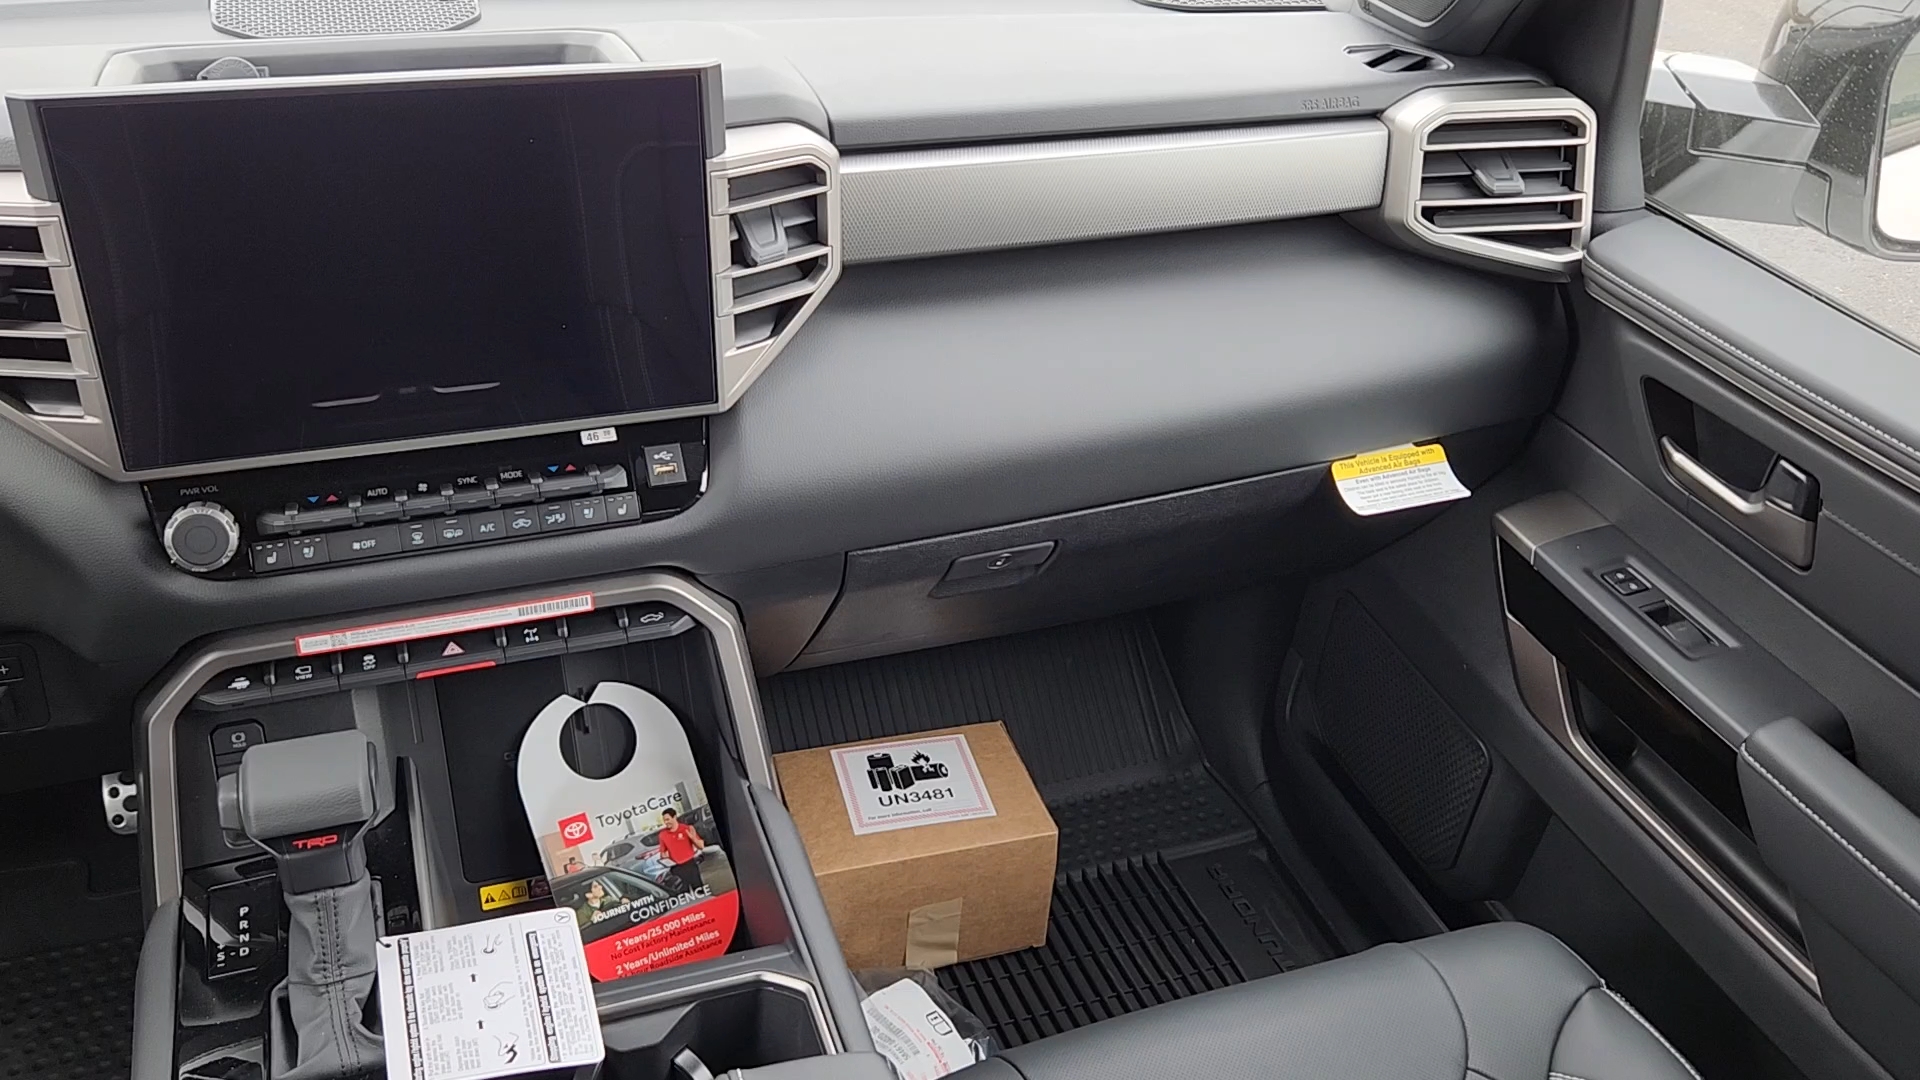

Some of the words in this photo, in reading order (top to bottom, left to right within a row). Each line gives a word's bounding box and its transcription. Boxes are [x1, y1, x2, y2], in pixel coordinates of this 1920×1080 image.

[1301, 99, 1319, 110] SRS
[1321, 96, 1360, 109] AIRBAG
[587, 432, 599, 441] 46
[1339, 460, 1355, 470] This
[1355, 456, 1379, 467] Vehicle
[1388, 450, 1420, 463] Equipped
[1420, 448, 1435, 457] with
[1359, 463, 1392, 474] Advanced
[1393, 460, 1403, 469] Air
[1404, 458, 1421, 469] Bags
[457, 476, 478, 485] SYNC
[500, 470, 523, 480] MODE
[180, 487, 200, 496] PWR
[201, 485, 219, 494] VOL
[367, 487, 388, 497] AUTO
[480, 523, 496, 532] A/C
[361, 539, 376, 549] OFF
[878, 787, 956, 808] UN3481
[595, 792, 683, 828] ToyotaCare
[591, 902, 631, 924] JOURNEY
[630, 894, 655, 909] WITH
[630, 884, 712, 923] CONFIDENCE
[610, 951, 623, 961] No
[623, 944, 641, 956] Cost
[641, 934, 669, 951] Factory
[669, 918, 716, 937] Maintenance
[615, 941, 623, 951] 2
[623, 920, 681, 947] Years/25,000
[681, 911, 706, 925] Miles
[616, 965, 623, 975] 2
[623, 938, 695, 972] Years/Unlimited
[695, 929, 720, 943] Miles
[650, 953, 684, 969] Roadside
[685, 939, 723, 957] Assistance
